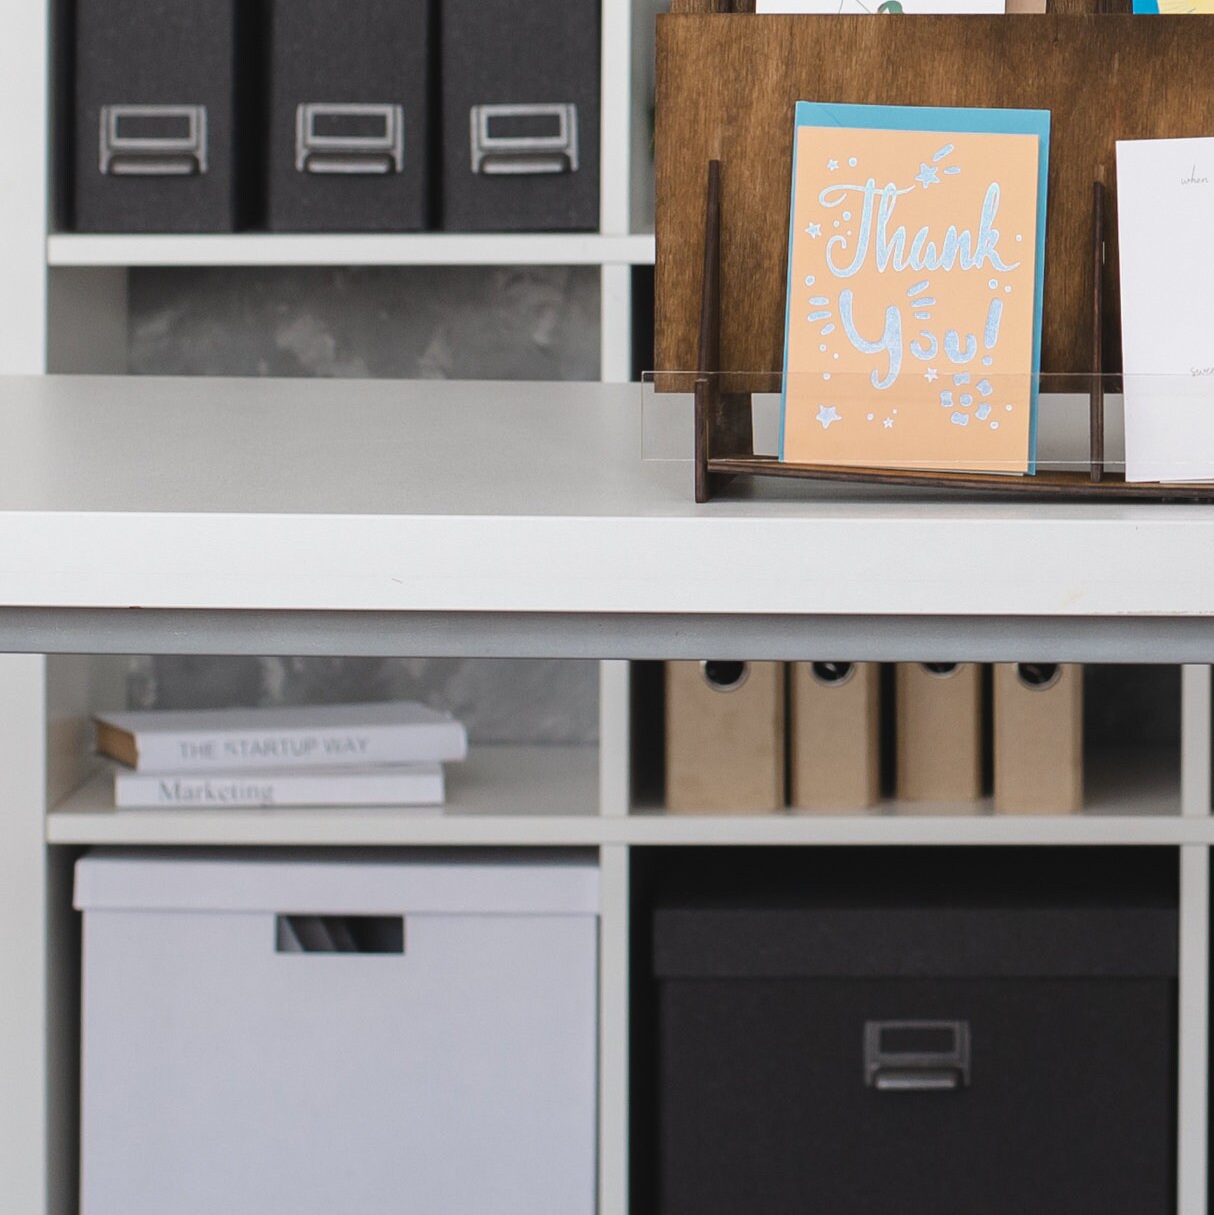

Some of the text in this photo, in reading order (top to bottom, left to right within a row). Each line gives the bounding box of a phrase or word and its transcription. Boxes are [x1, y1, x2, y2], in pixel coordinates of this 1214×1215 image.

[1180, 164, 1209, 186] when
[817, 177, 1021, 278] Thank
[838, 288, 1003, 390] You!
[178, 736, 369, 761] THE STARTUP WAY
[157, 782, 276, 806] Marketing
